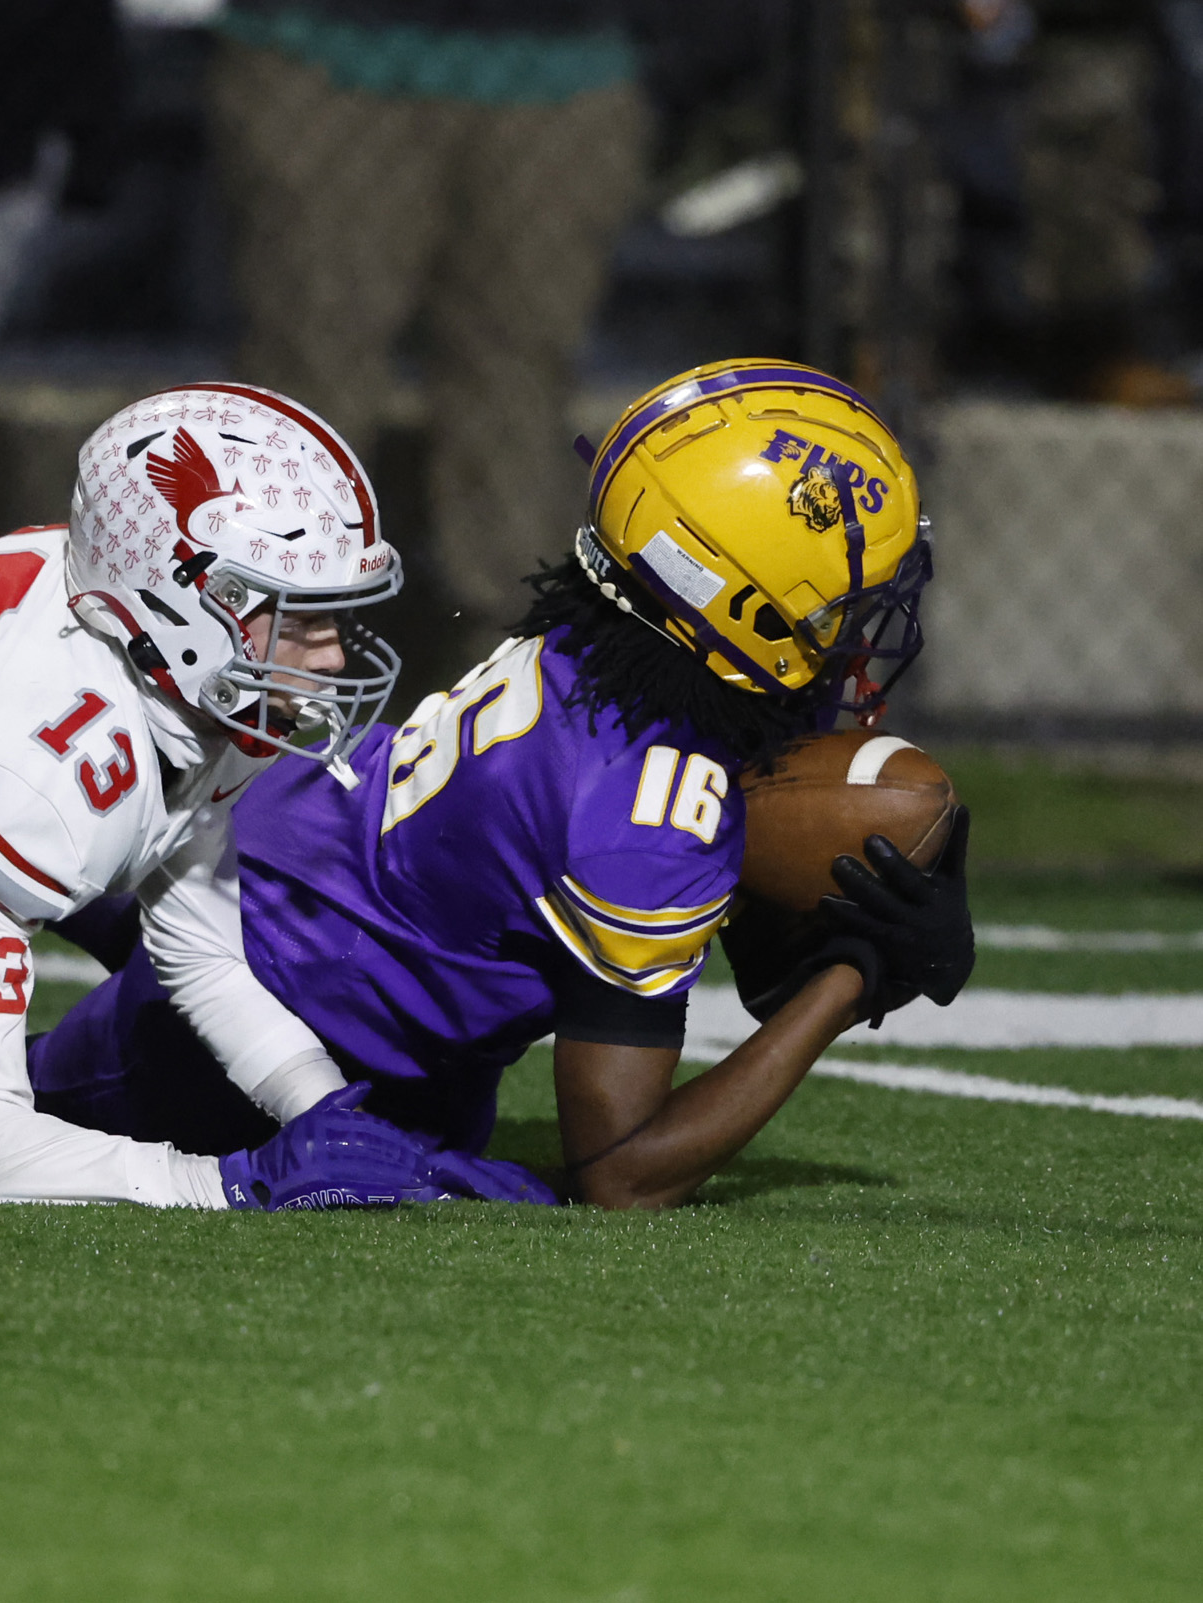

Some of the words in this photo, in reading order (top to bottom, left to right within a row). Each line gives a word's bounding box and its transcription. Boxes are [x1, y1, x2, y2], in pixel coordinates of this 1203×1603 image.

[360, 546, 391, 574] Riddell
[676, 548, 704, 573] WARNING
[29, 687, 139, 818] 13
[631, 745, 729, 844] 16
